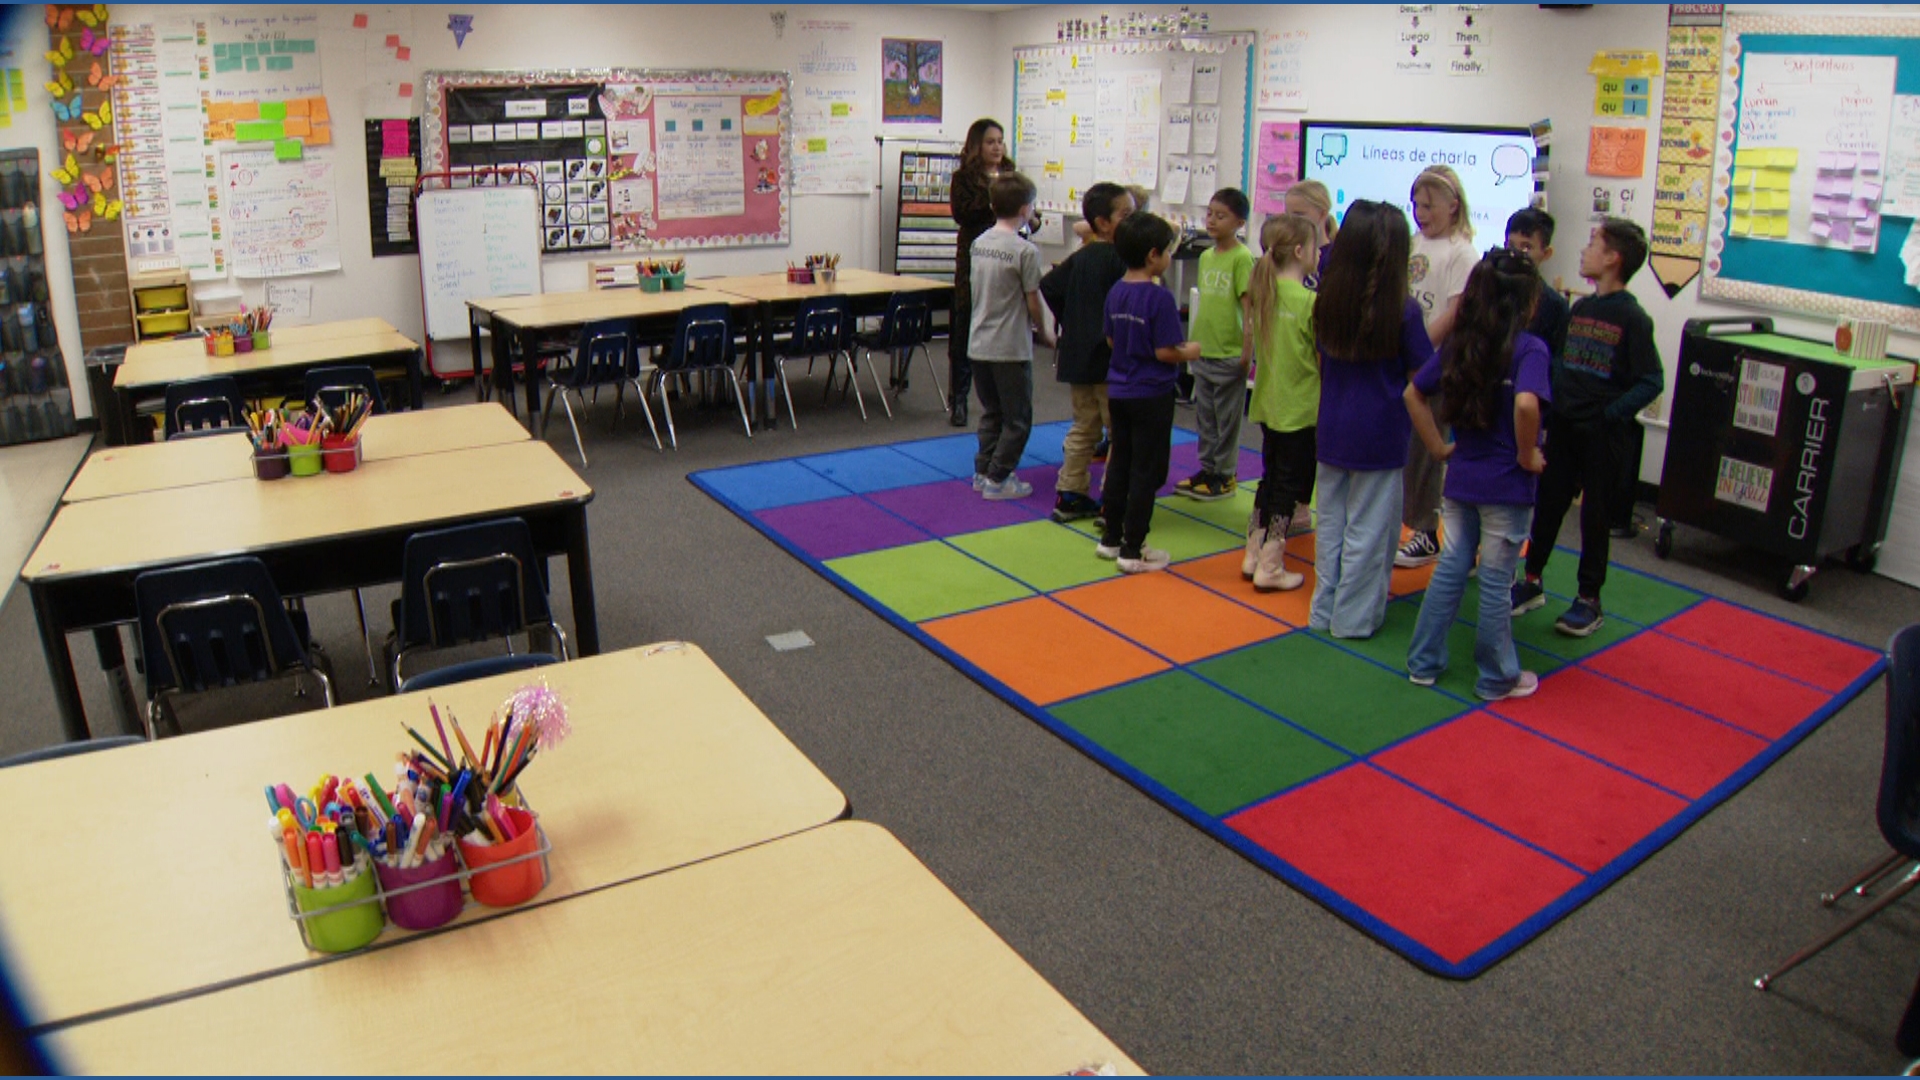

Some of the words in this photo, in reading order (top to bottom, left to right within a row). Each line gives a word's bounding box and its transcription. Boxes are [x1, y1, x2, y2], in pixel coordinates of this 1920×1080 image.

[1401, 32, 1430, 43] Luego
[1451, 61, 1485, 73] Finally,
[1602, 82, 1618, 94] qu
[1601, 101, 1617, 113] qu
[1362, 144, 1405, 162] Líneas
[1409, 147, 1426, 162] de
[1431, 149, 1477, 166] charla
[1593, 187, 1610, 200] Ce
[1730, 460, 1771, 490] BELIEVE
[1788, 397, 1830, 540] CARRIER
[1718, 478, 1732, 494] IN
